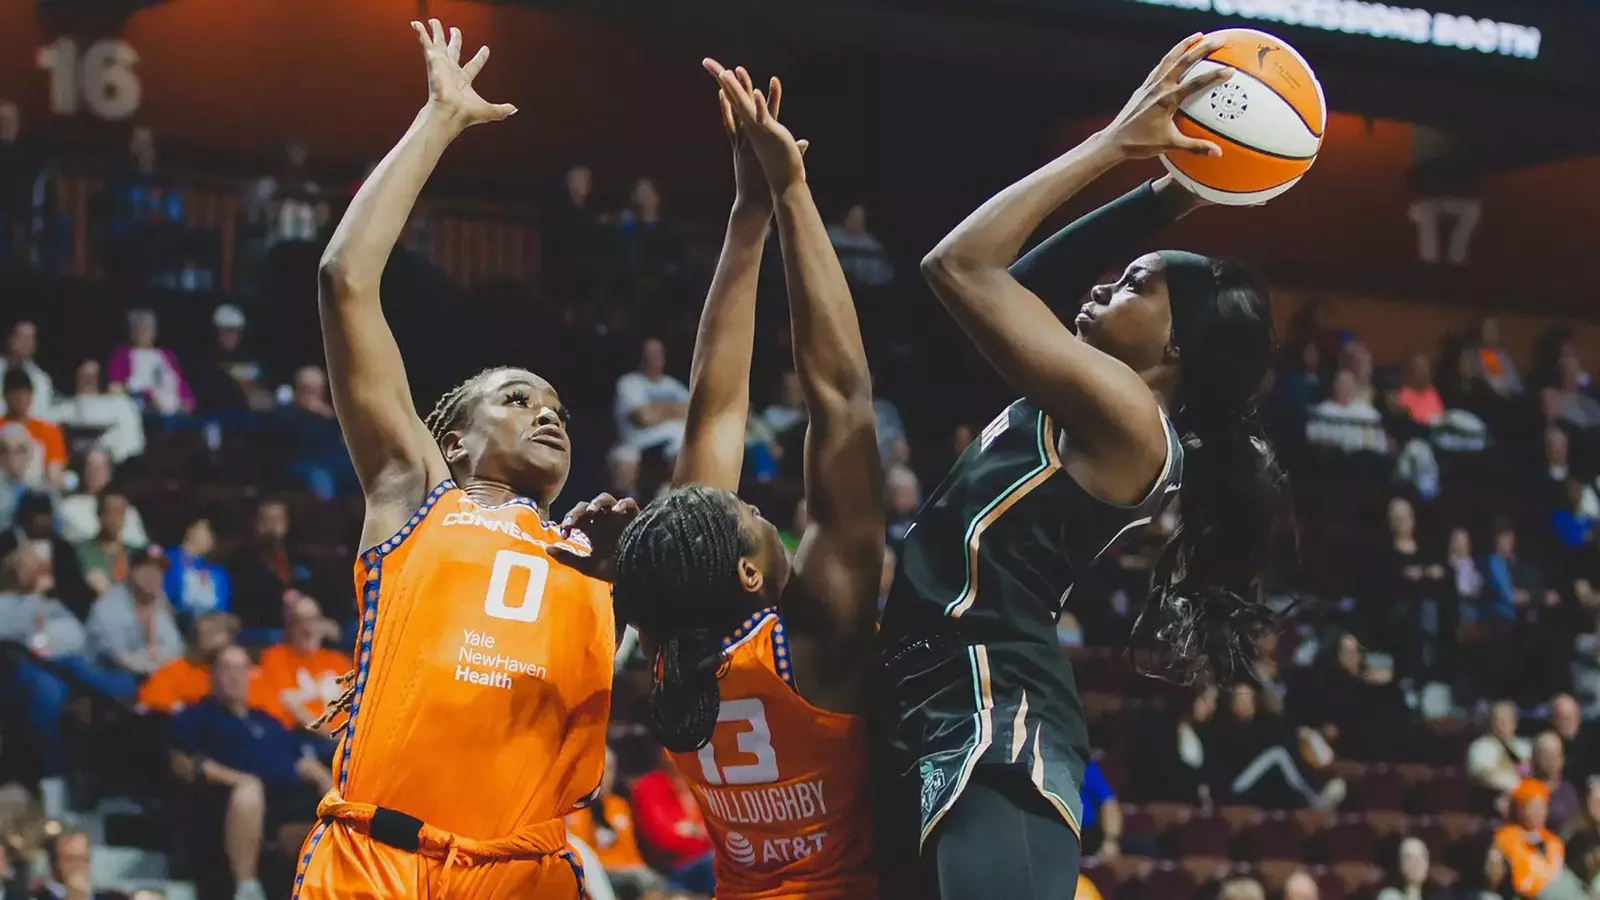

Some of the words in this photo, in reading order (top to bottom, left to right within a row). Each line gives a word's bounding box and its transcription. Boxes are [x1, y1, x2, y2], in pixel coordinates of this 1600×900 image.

[1432, 12, 1542, 60] BOOTH
[37, 36, 142, 119] 16
[1408, 198, 1480, 262] 17
[442, 511, 592, 558] CONNEC
[484, 549, 550, 622] 0
[464, 628, 496, 649] Yale
[455, 664, 514, 690] Health
[458, 646, 548, 680] NewHaven
[698, 779, 827, 824] WILLOUGHBY
[763, 831, 828, 863] AT&T
